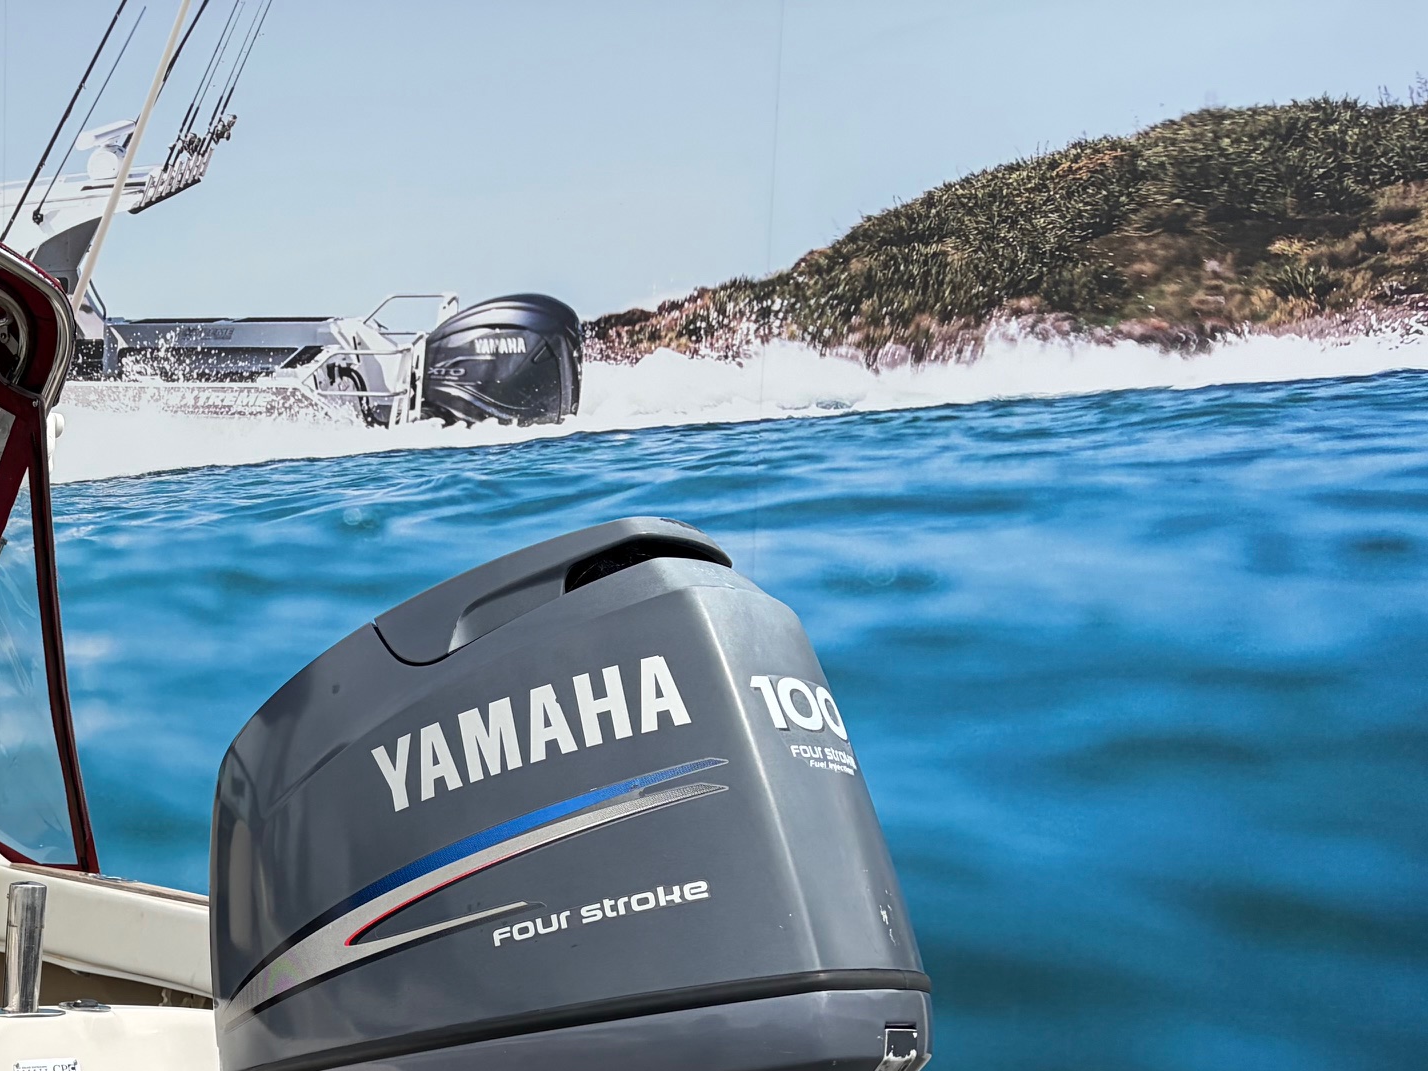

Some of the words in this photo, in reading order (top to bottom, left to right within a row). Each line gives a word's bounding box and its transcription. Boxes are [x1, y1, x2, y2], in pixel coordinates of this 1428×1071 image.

[474, 337, 527, 354] YAMAHA
[428, 367, 466, 376] XTO
[750, 676, 848, 741] 100
[371, 655, 692, 812] YAMAHA
